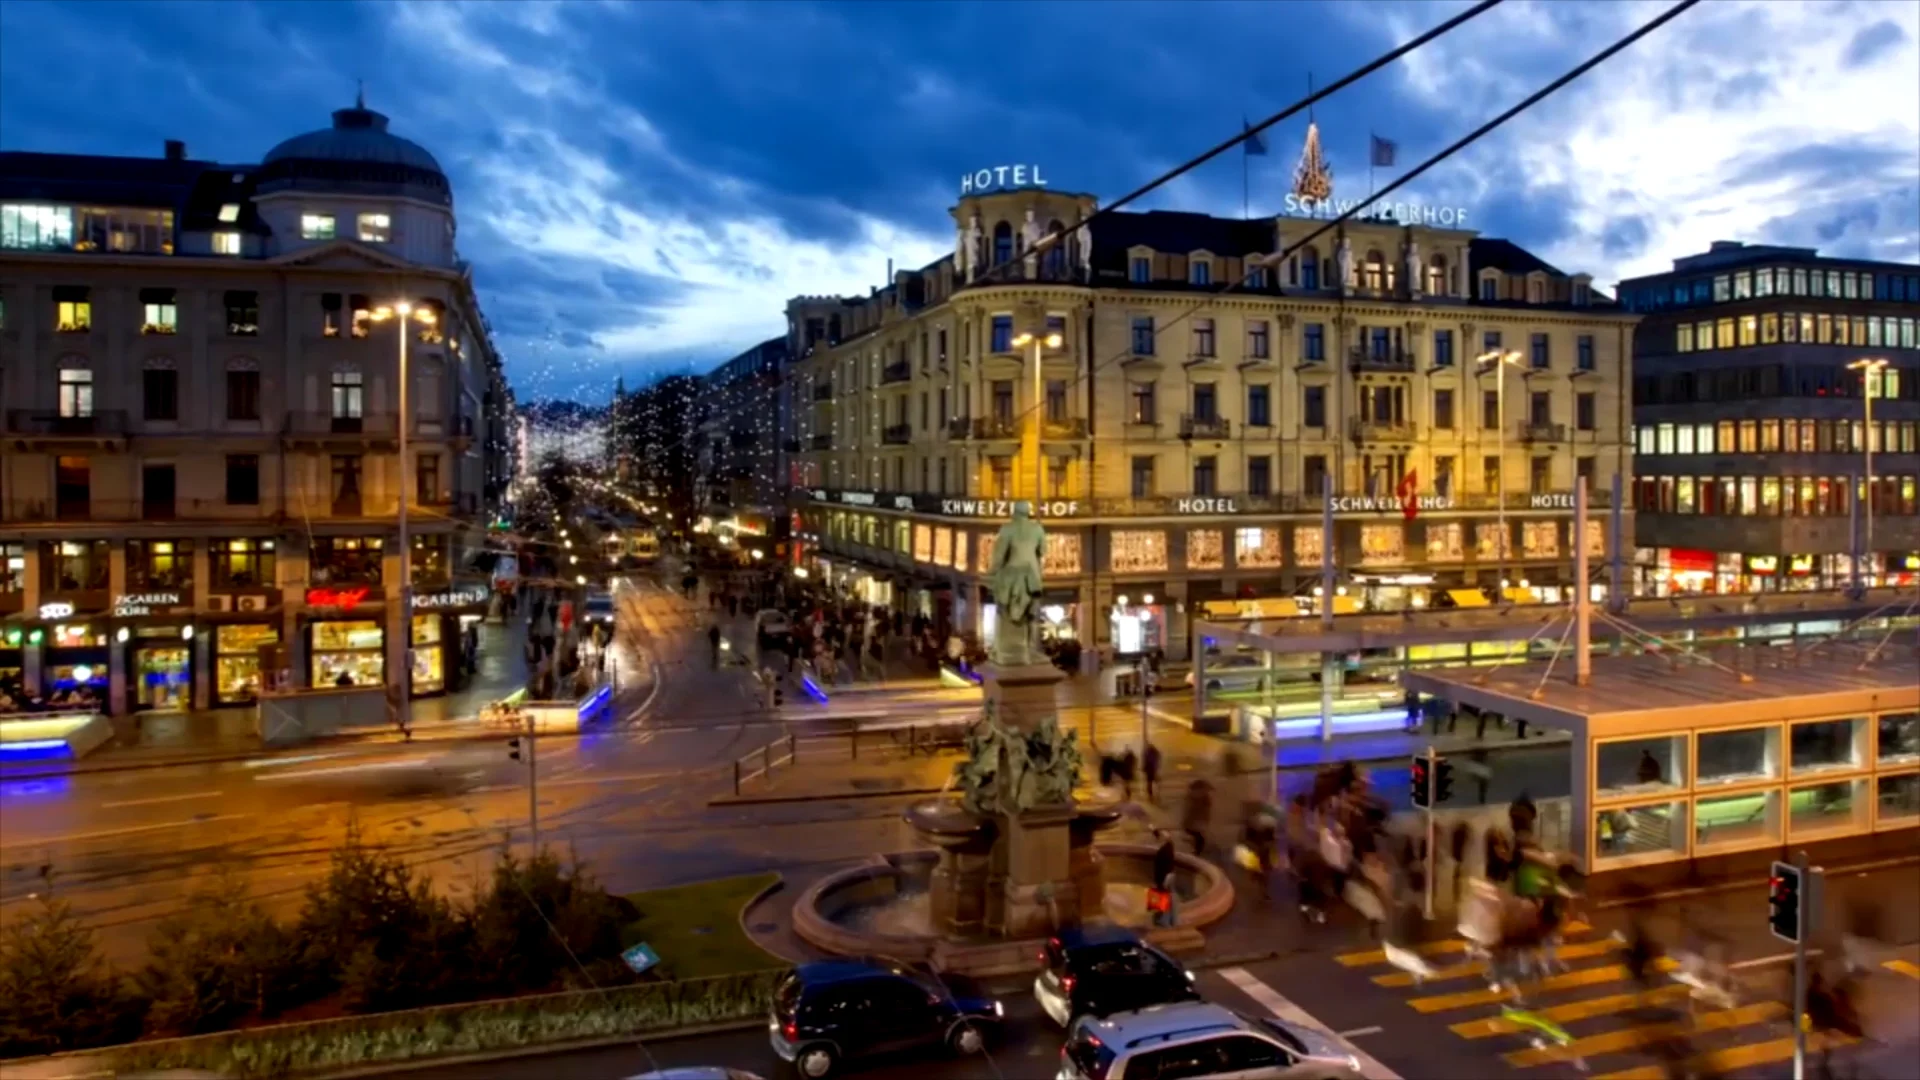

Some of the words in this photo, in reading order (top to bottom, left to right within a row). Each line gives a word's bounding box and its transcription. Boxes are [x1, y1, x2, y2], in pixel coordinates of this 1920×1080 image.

[961, 164, 1048, 194] HOTEL
[1179, 499, 1237, 513] HOTEL
[1330, 496, 1456, 511] SCHWEIZRHOF
[1531, 494, 1575, 508] HOTEL
